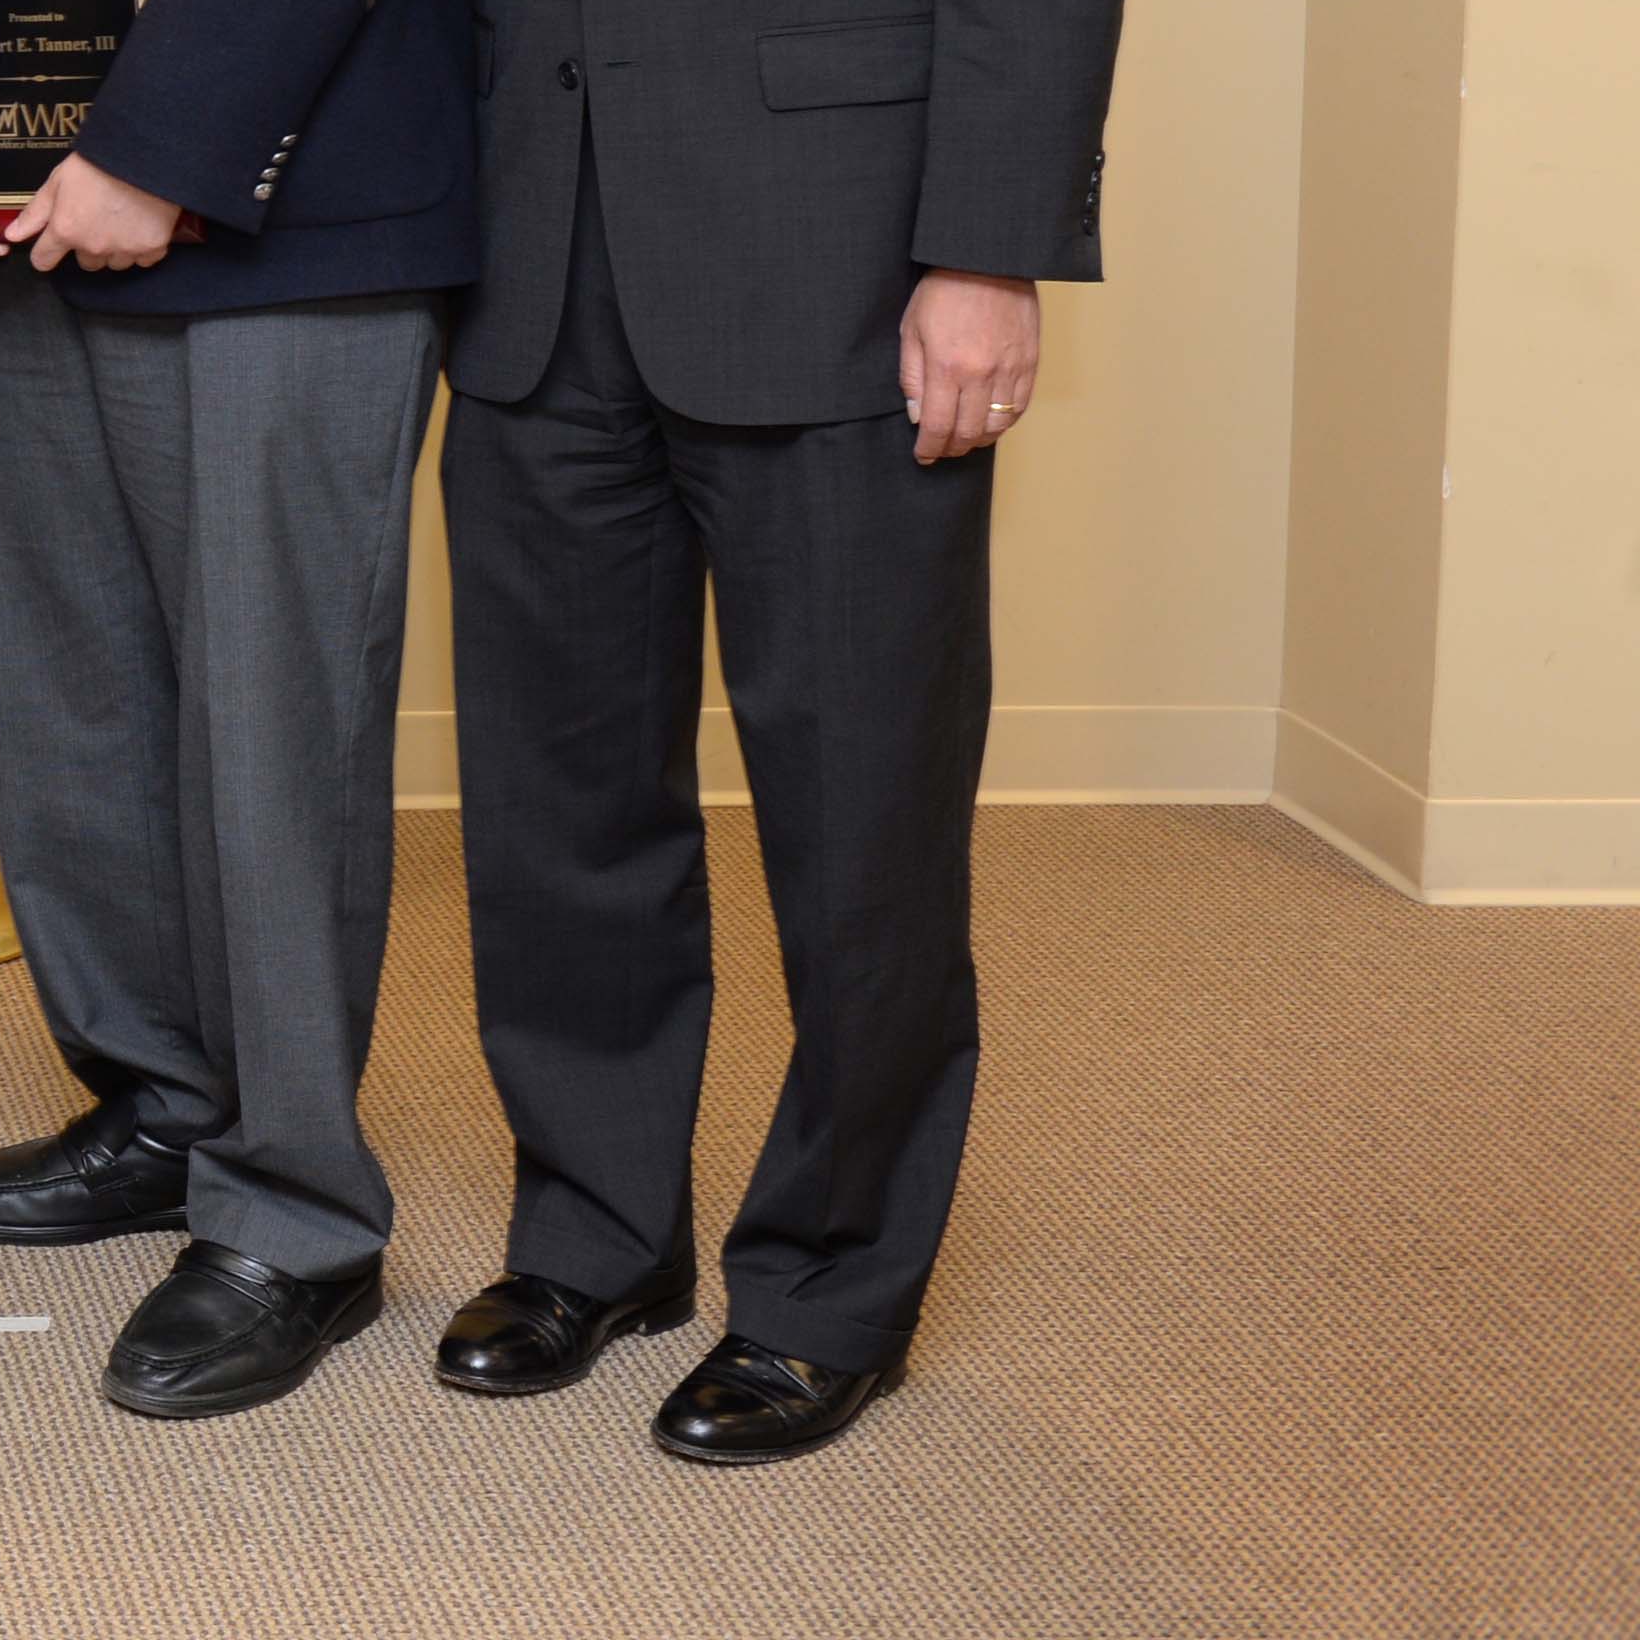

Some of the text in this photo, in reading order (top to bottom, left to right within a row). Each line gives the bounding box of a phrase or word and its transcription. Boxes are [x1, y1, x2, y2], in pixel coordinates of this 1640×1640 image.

[54, 12, 65, 22] to
[16, 38, 32, 53] E.
[35, 37, 92, 55] Tanner,
[95, 35, 116, 51] III
